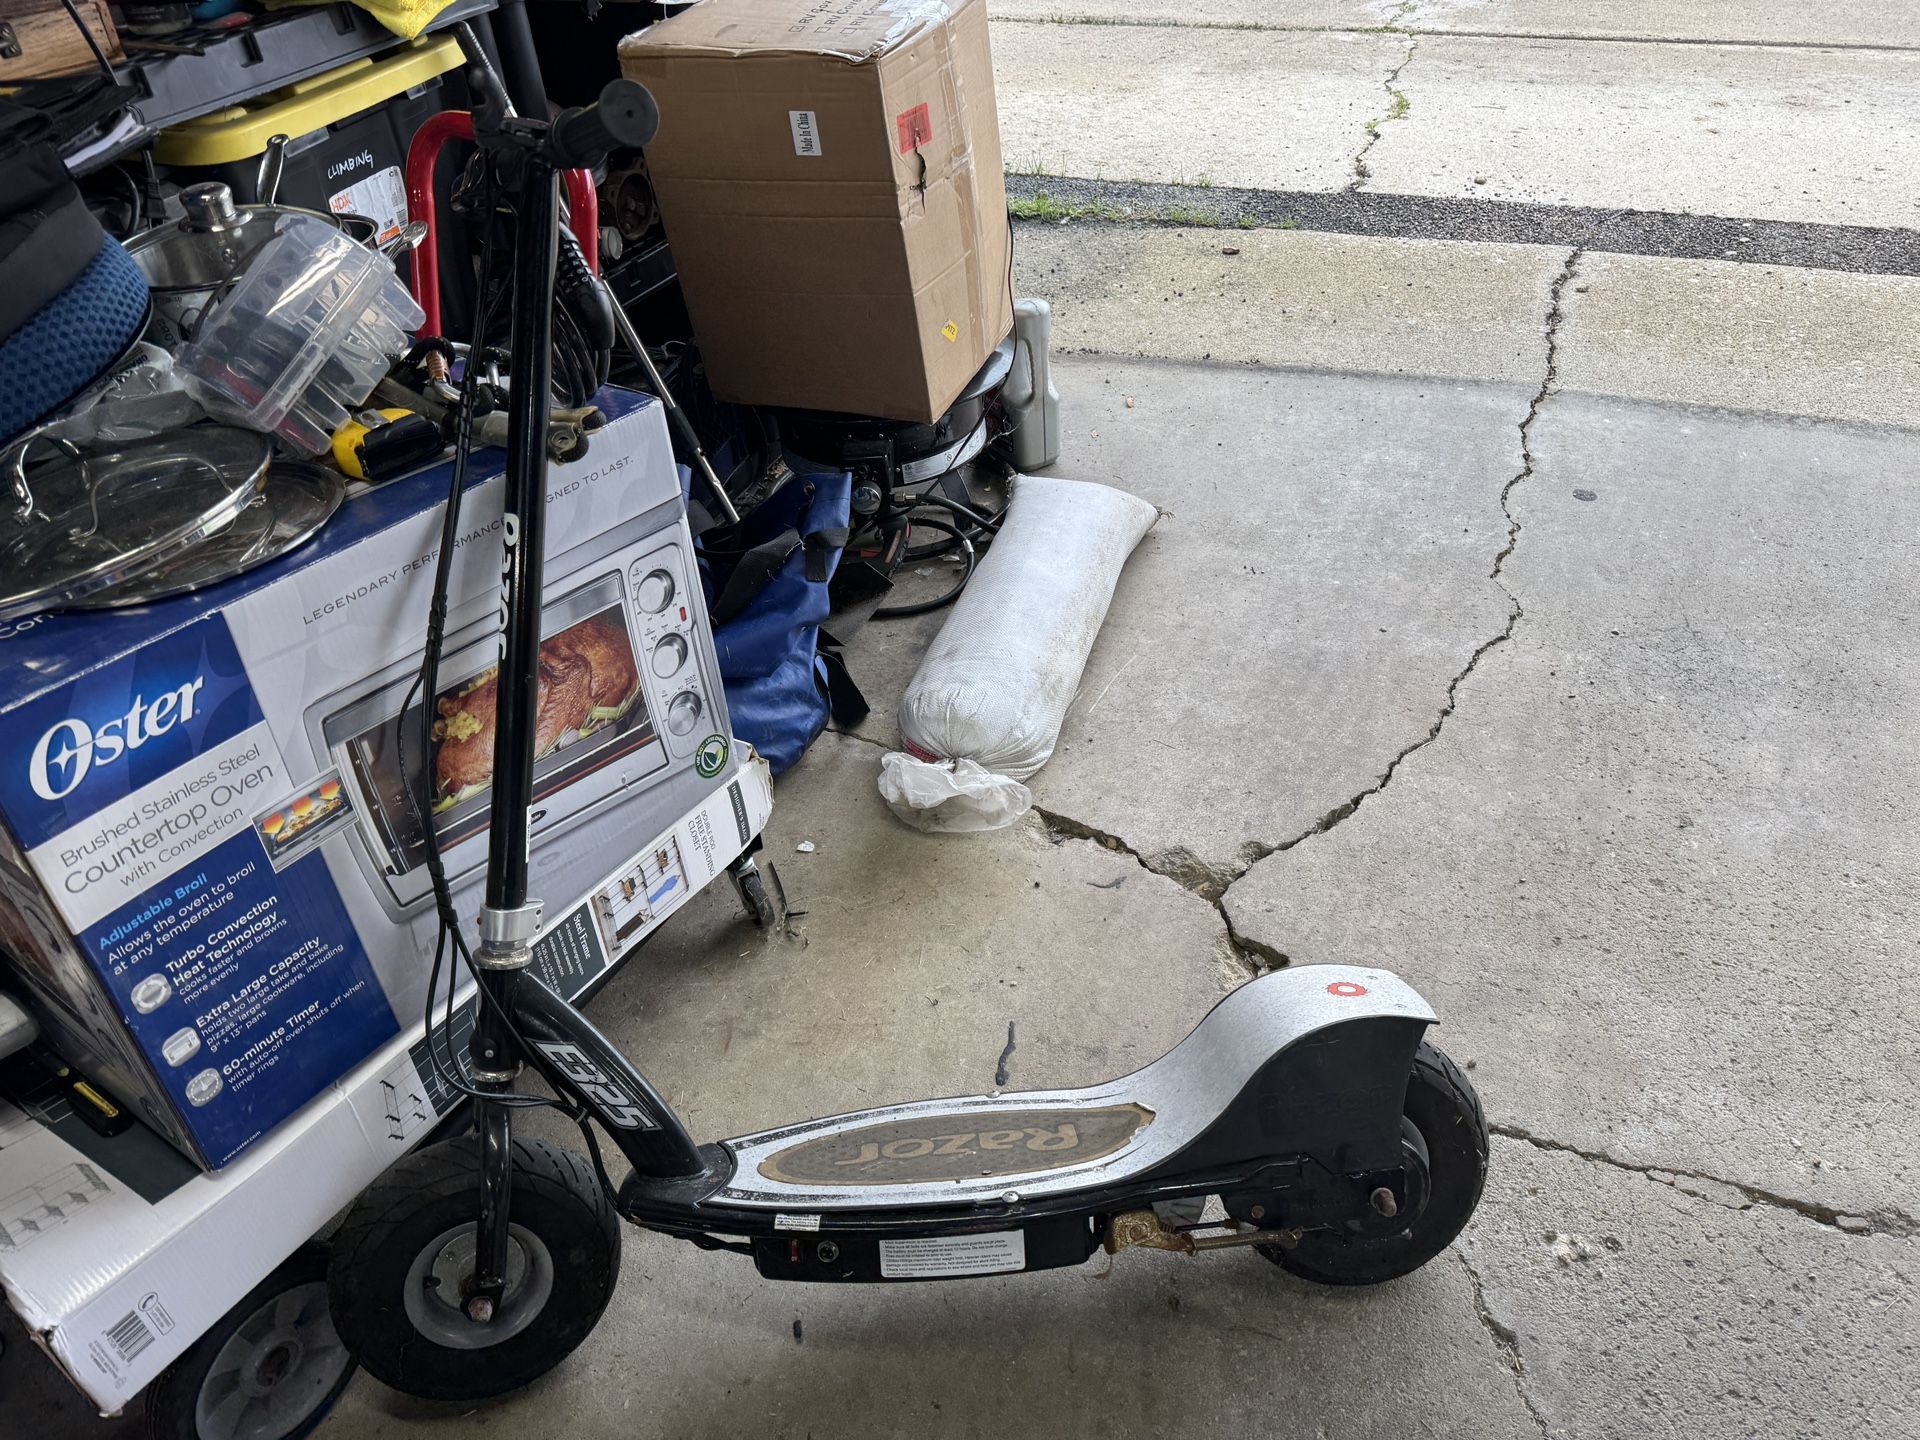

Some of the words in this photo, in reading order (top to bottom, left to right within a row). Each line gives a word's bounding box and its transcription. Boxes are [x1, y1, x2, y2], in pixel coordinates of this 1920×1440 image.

[798, 14, 816, 24] RV
[811, 0, 832, 13] Cov
[824, 15, 841, 25] RV
[849, 16, 867, 26] RV
[797, 113, 811, 130] China
[801, 137, 814, 153] Made
[327, 149, 374, 180] CLIMBING
[331, 192, 353, 213] HDX
[302, 570, 397, 625] LEGENDARY
[402, 516, 505, 575] PERFRMANC
[545, 481, 580, 503] GNED
[582, 472, 599, 485] TO
[601, 456, 634, 477] LAST.
[29, 676, 204, 801] Oster
[60, 811, 142, 868] Brushed
[142, 771, 217, 820] Stainless
[218, 743, 261, 777] Steel
[64, 803, 207, 894] Countertop
[211, 765, 274, 807] Oven
[688, 820, 702, 851] CLOSET
[700, 810, 713, 835] DOUBLE
[731, 785, 745, 822] DESIGNER'S
[120, 858, 156, 887] with
[158, 807, 244, 863] Convection
[694, 814, 706, 836] FREE
[701, 834, 716, 876] STANDING
[100, 897, 173, 949] Adjustable
[174, 872, 208, 899] Broil
[108, 930, 152, 964] Allows
[153, 914, 176, 933] the
[178, 893, 210, 917] oven
[211, 883, 225, 895] to
[227, 861, 256, 885] broil
[113, 960, 129, 975] at
[130, 943, 153, 964] any
[156, 891, 234, 946] temperature
[165, 944, 206, 973] Turbo
[207, 895, 278, 945] Convection
[573, 913, 586, 936] Steel
[172, 960, 206, 987] Heat
[205, 911, 277, 963] Technology
[179, 973, 207, 995] cooks
[208, 953, 235, 975] faster
[236, 941, 254, 956] and
[254, 918, 287, 943] browns
[579, 932, 591, 960] Frame
[183, 984, 209, 1005] more
[210, 962, 239, 986] evenly
[195, 1000, 231, 1029] Extra
[231, 974, 268, 1003] Large
[269, 937, 320, 976] Capacity
[201, 1016, 227, 1037] holds
[227, 1002, 246, 1018] two
[246, 986, 270, 1004] large
[270, 971, 290, 987] take
[291, 958, 308, 973] and
[308, 943, 329, 960] bake
[206, 1022, 238, 1047] pizzas,
[238, 1003, 261, 1021] large
[262, 972, 306, 1005] cookware,
[305, 943, 344, 973] including
[222, 1026, 286, 1075] 60-minute
[286, 1000, 320, 1028] Timer
[223, 1037, 230, 1045] x
[245, 1010, 267, 1029] pans
[227, 1066, 249, 1084] with
[249, 1038, 284, 1068] auto-off
[285, 1025, 306, 1042] oven
[307, 1007, 330, 1026] shuts
[330, 995, 342, 1009] off
[342, 980, 365, 999] when
[232, 1072, 256, 1092] timer
[257, 1054, 279, 1075] rings
[533, 1041, 660, 1130] E325
[833, 1122, 1081, 1166] Razor
